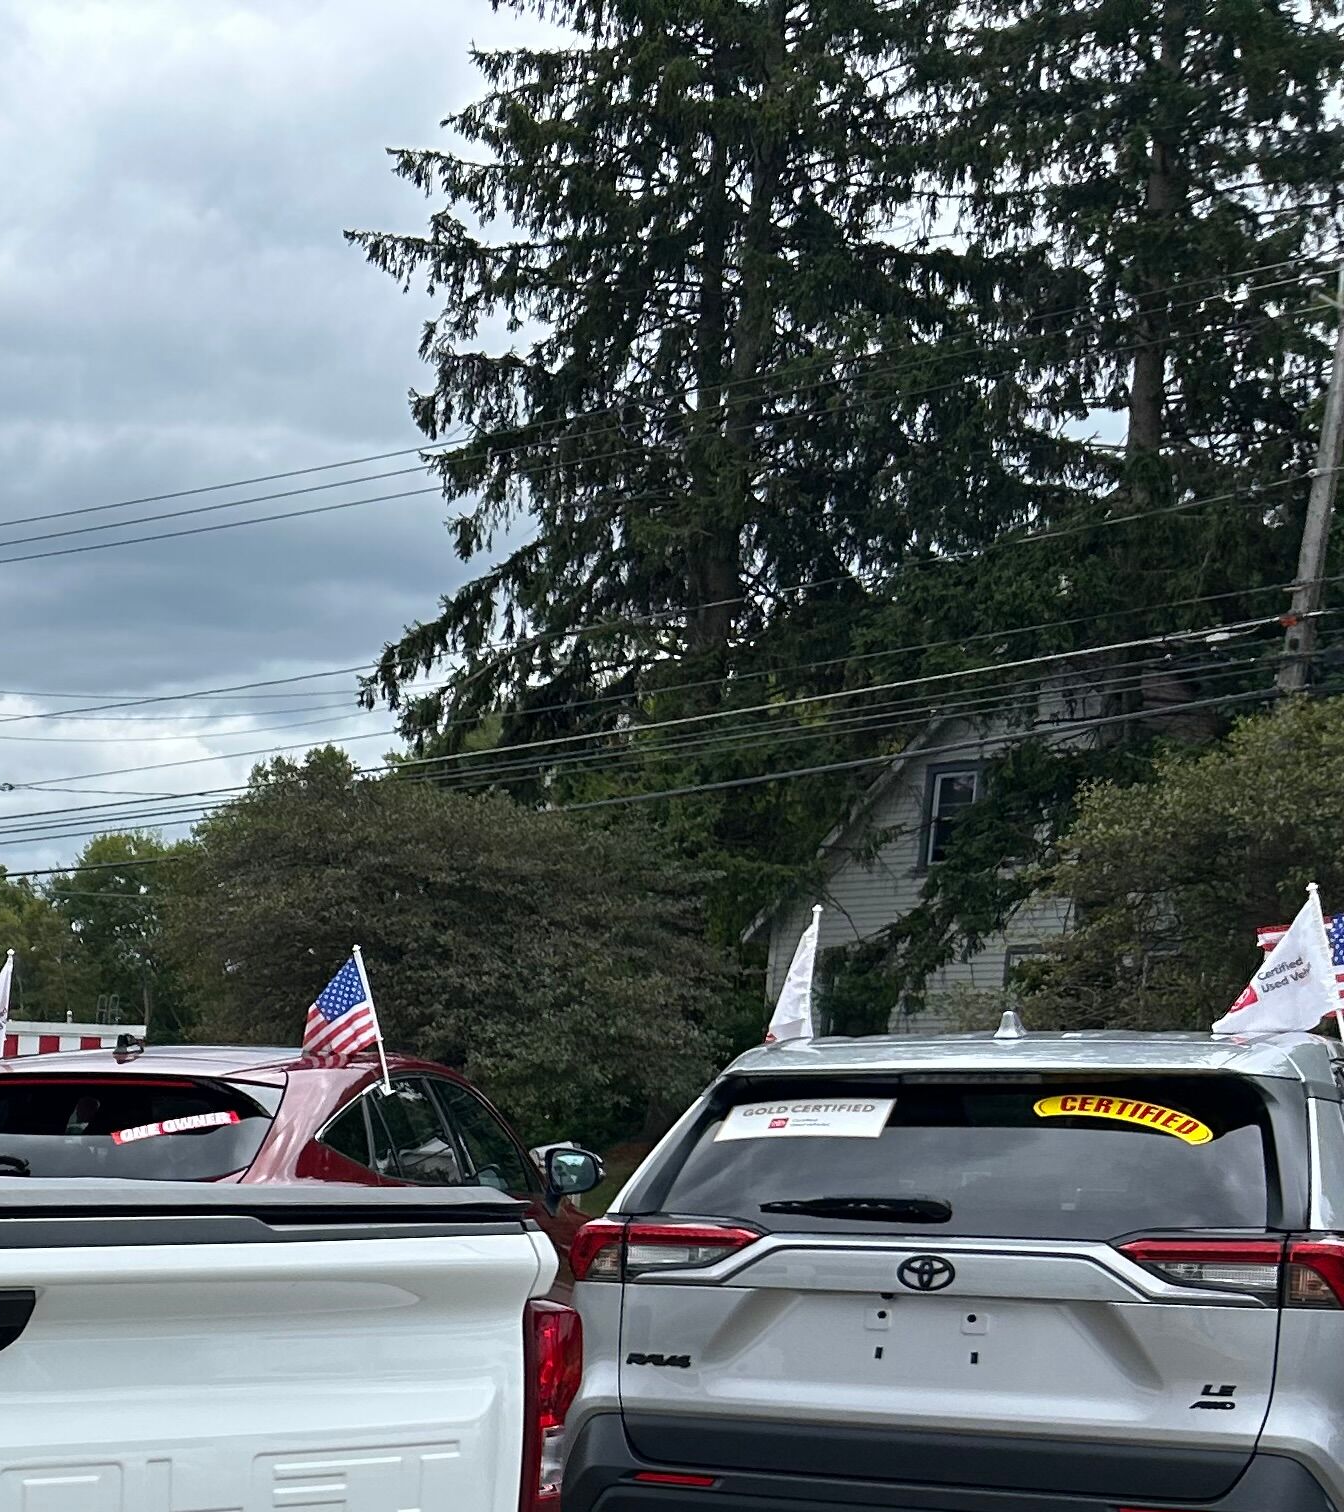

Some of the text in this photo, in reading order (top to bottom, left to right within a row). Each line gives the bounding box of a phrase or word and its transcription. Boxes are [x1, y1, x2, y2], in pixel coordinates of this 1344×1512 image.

[1257, 957, 1304, 980] Certified
[1261, 977, 1289, 993] Used
[743, 1104, 876, 1117] GOLD CERTIFIED
[1060, 1096, 1200, 1135] CERTIFIED
[120, 1111, 231, 1142] ONE OWNER
[1201, 1384, 1237, 1396] LE
